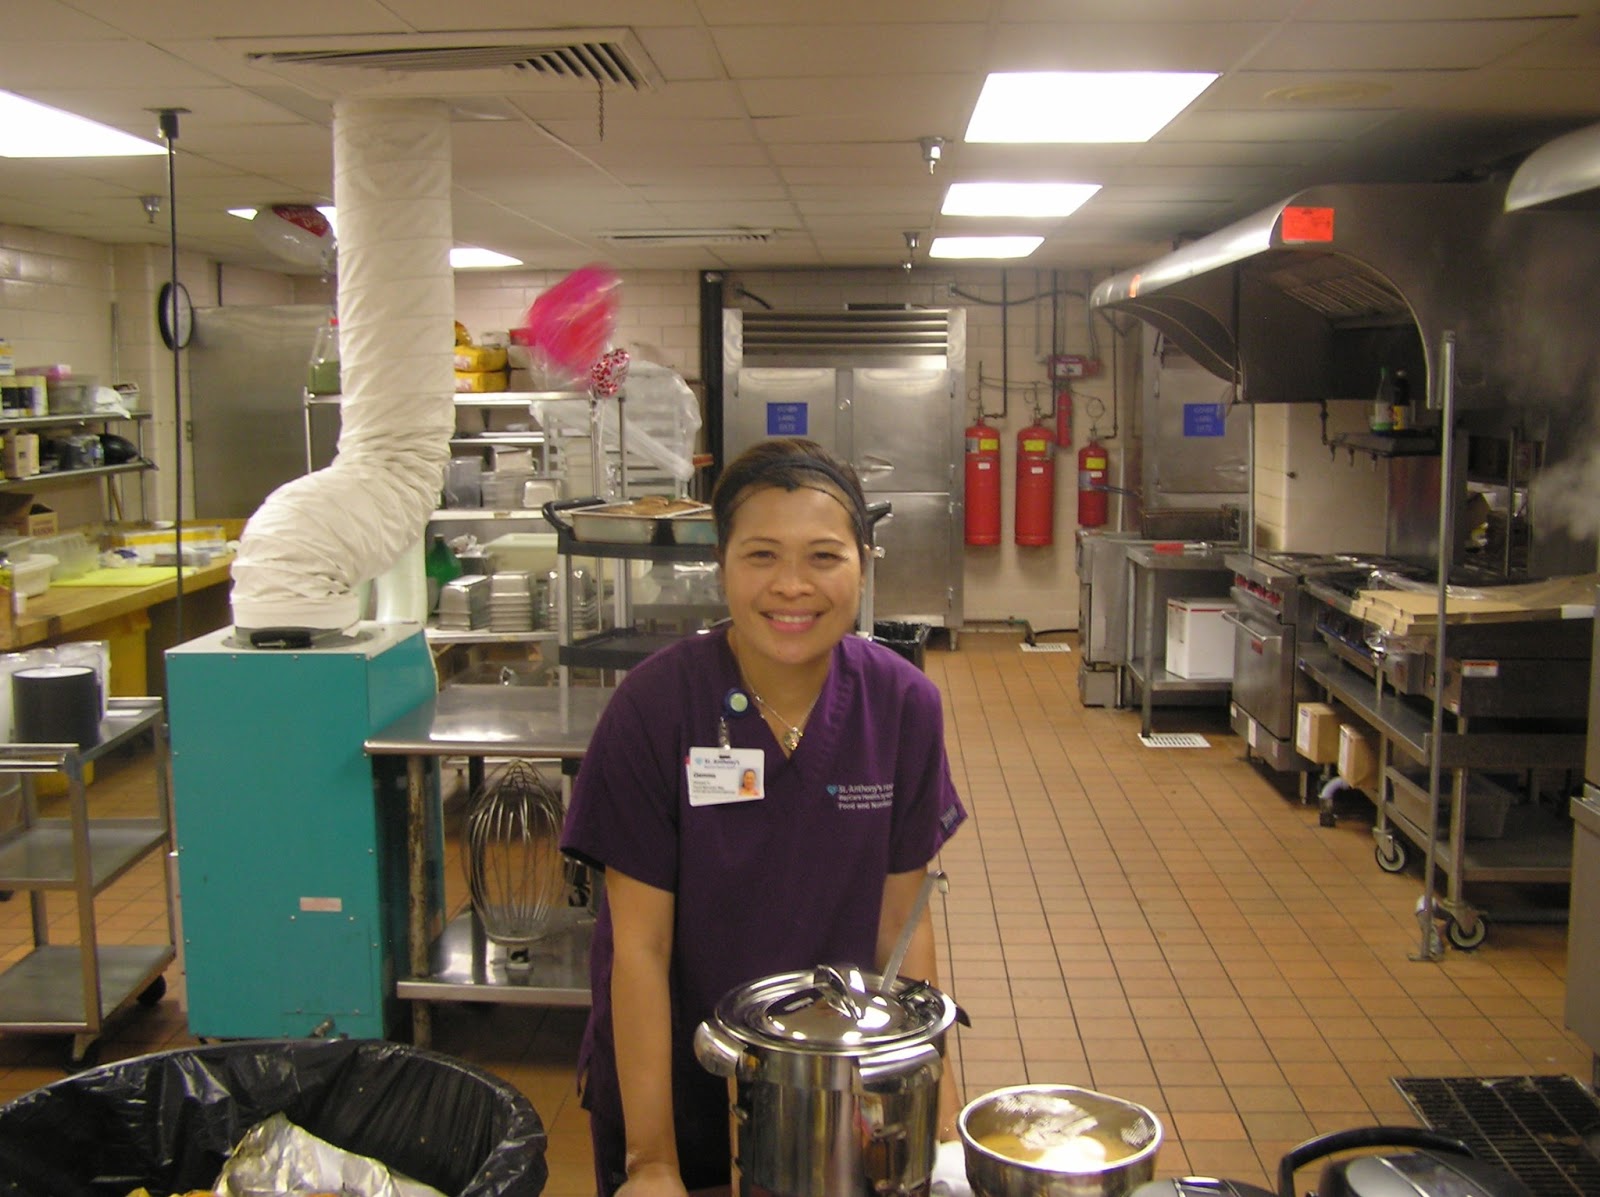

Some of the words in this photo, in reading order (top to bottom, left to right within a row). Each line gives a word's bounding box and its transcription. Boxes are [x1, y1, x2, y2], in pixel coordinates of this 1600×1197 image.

[848, 783, 883, 794] Anthony's
[838, 802, 856, 811] Food
[857, 801, 871, 810] and
